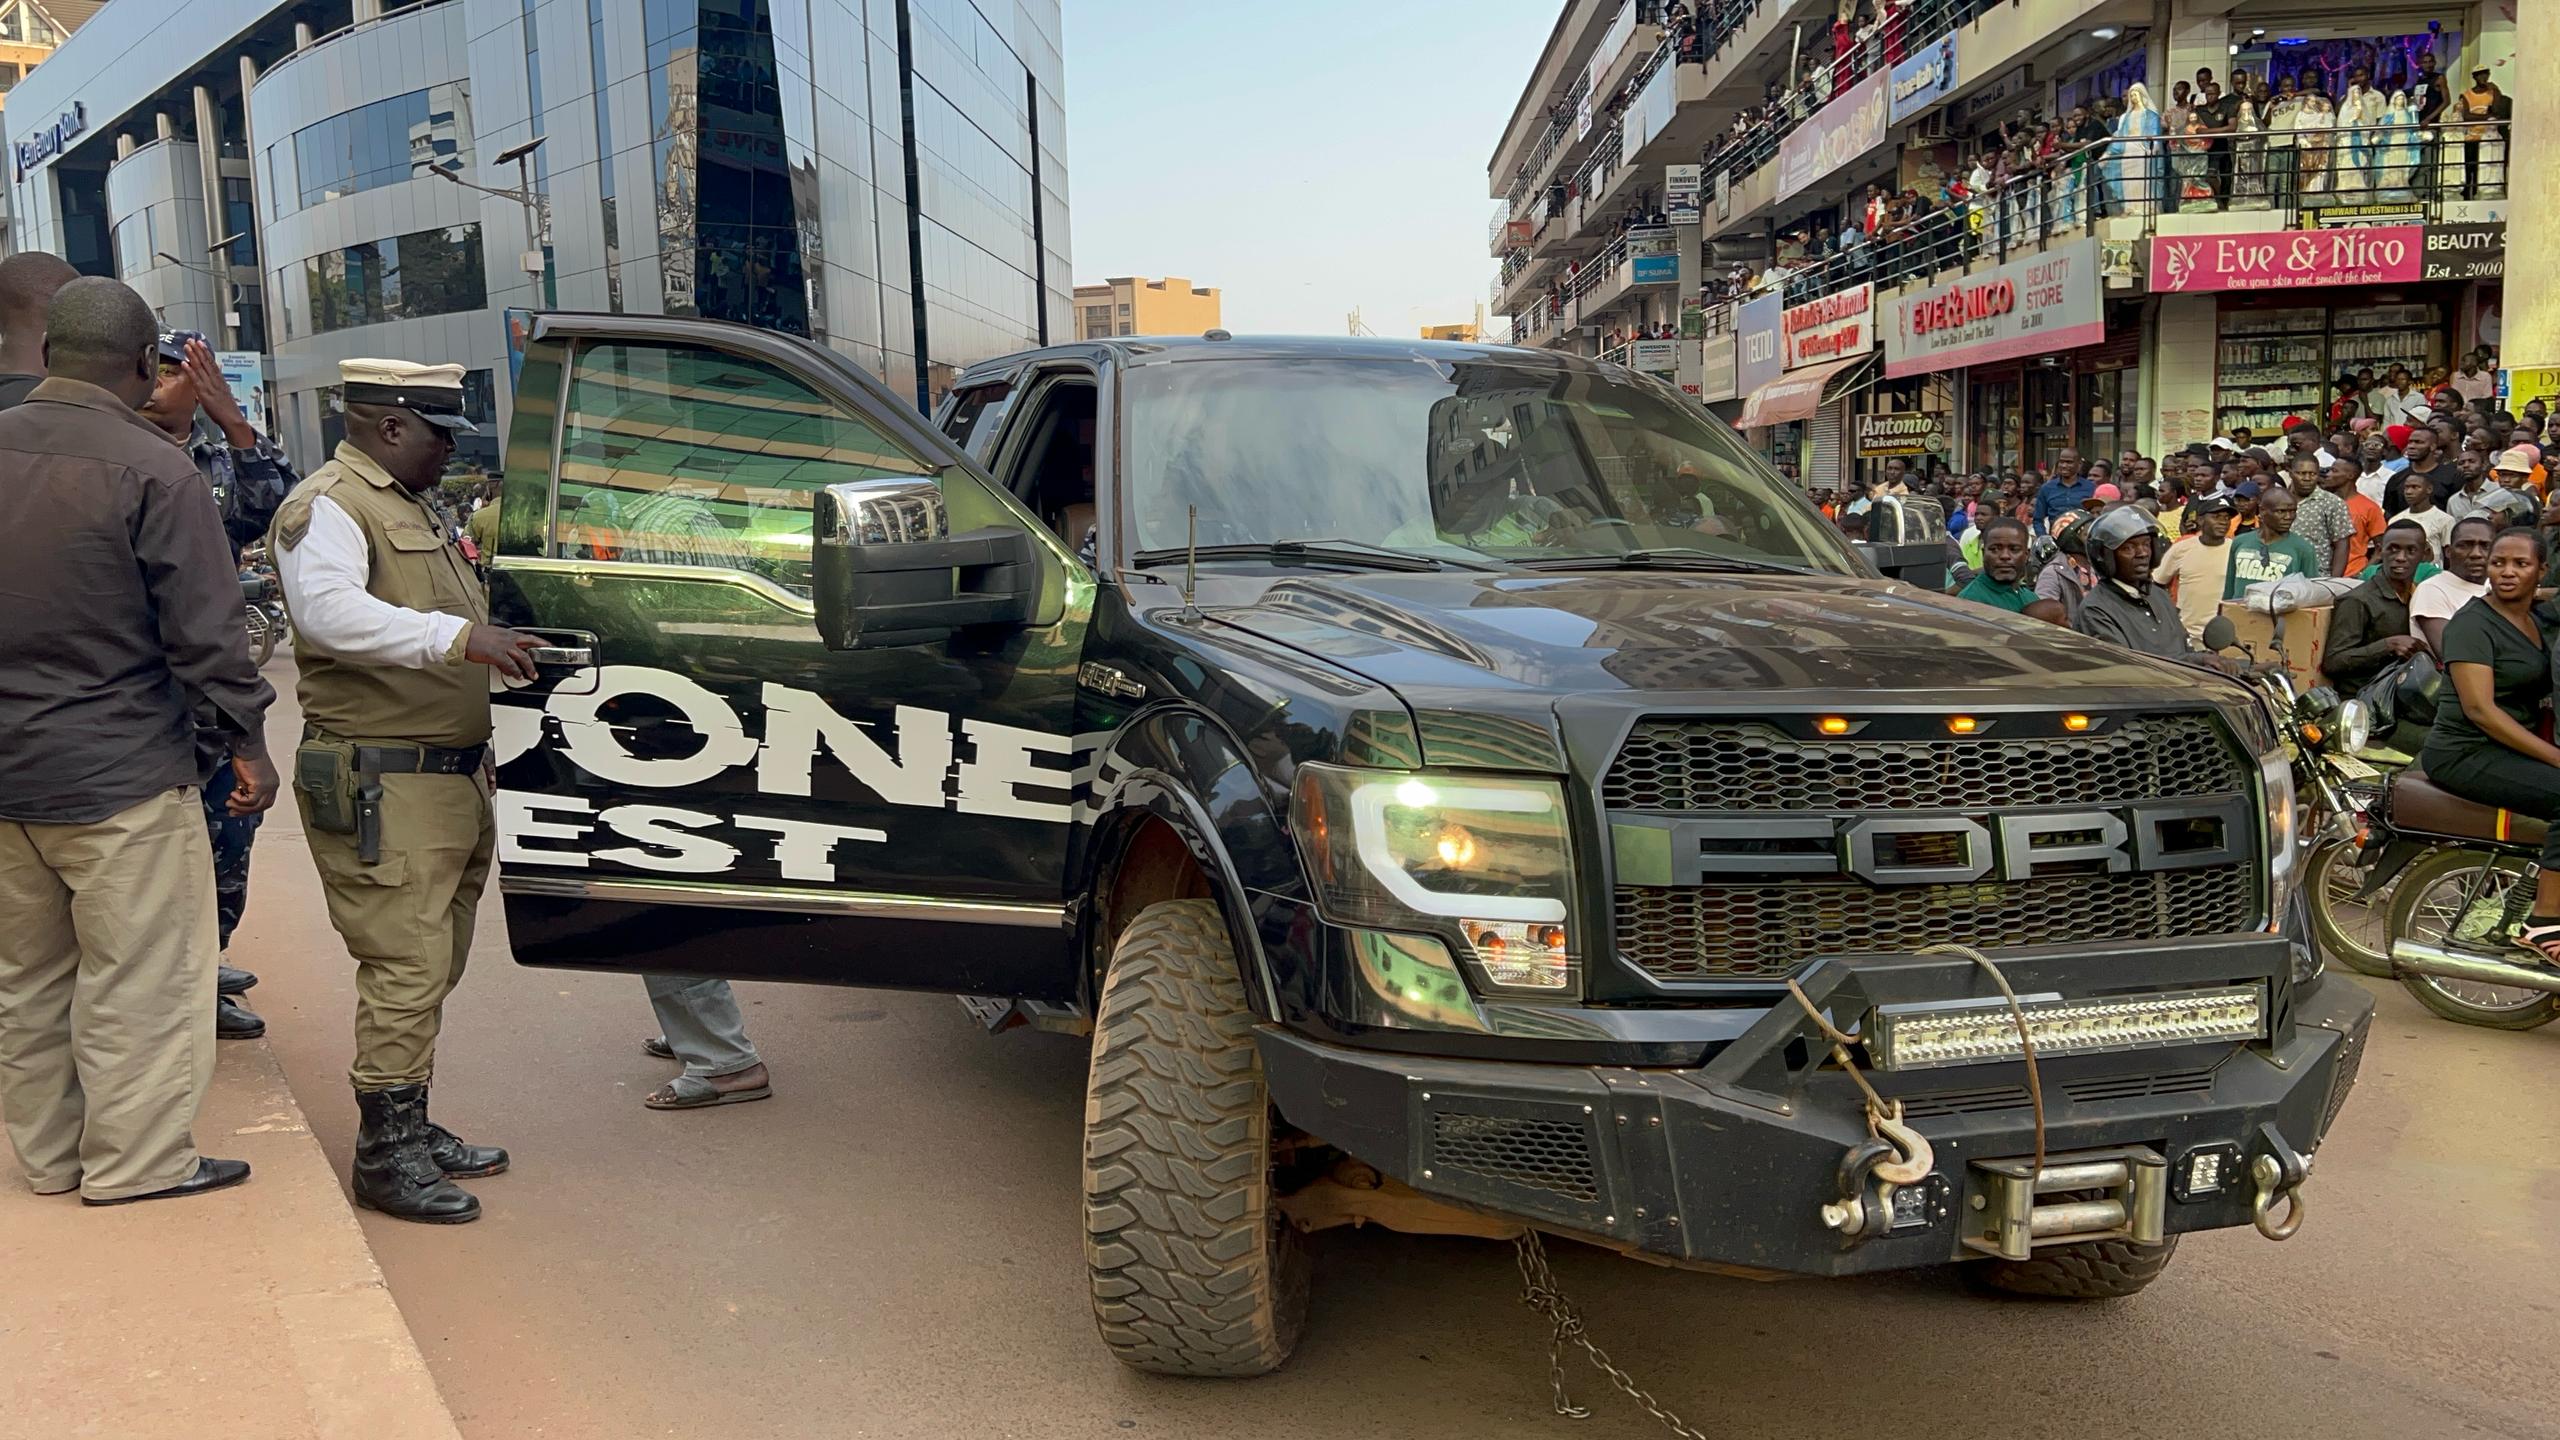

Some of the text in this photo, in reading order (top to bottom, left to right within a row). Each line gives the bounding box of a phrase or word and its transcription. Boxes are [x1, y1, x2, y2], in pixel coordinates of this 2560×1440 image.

[2320, 203, 2423, 216] FIRMWARE INVESTMENTS LTD
[2216, 233, 2405, 273] Eve & Nico
[2427, 232, 2494, 251] BEAUTY
[2027, 257, 2071, 289] BEAUTY
[2250, 277, 2269, 289] your
[2272, 274, 2292, 287] skin
[2295, 272, 2313, 286] and
[2345, 271, 2358, 284] the
[2465, 261, 2503, 277] 2000
[2027, 284, 2064, 311] STORE
[1745, 329, 1774, 365] TECNO
[1860, 412, 1944, 437] Antonio's
[1864, 436, 1925, 449] Takeaway
[1611, 808, 2252, 888] FORD
